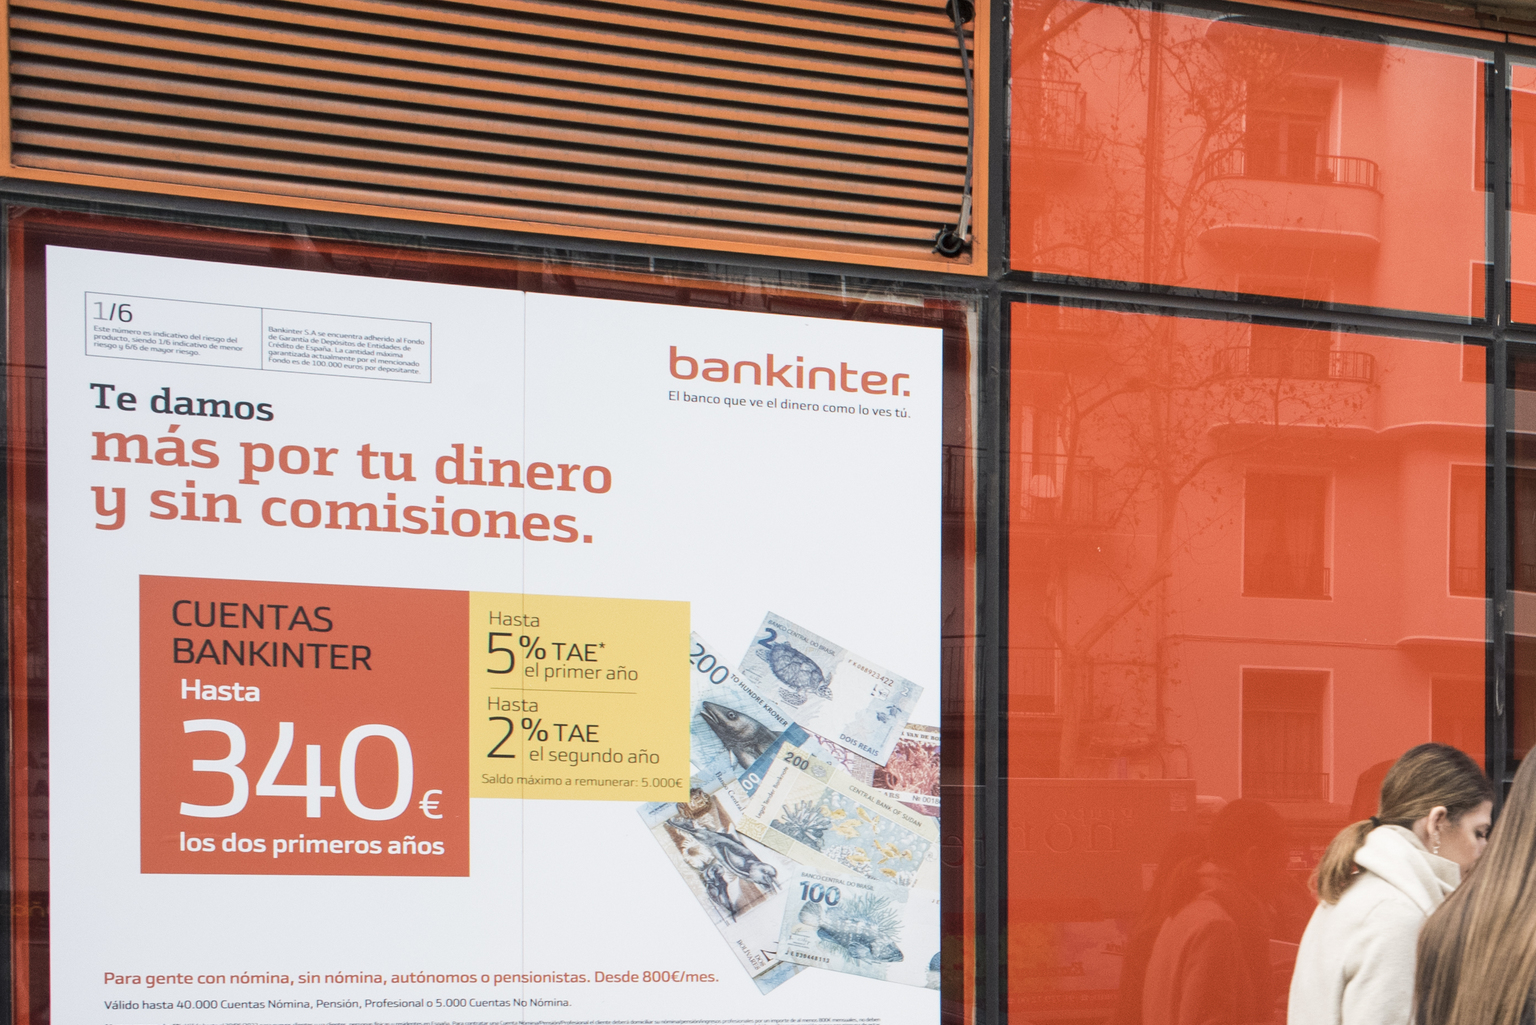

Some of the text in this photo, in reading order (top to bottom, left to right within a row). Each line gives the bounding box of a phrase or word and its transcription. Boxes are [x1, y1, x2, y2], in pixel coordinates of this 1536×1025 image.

[93, 302, 133, 323] 1/6
[94, 325, 110, 333] Este
[112, 327, 141, 335] número
[153, 331, 188, 339] indicativo
[203, 335, 225, 343] riesgo
[94, 334, 130, 342] producto,
[132, 336, 157, 344] siendo
[172, 340, 207, 348] indicativo
[268, 326, 303, 335] Bankinter
[327, 332, 363, 340] encuentra
[279, 335, 309, 343] Garantía
[321, 338, 355, 347] Depósitos
[367, 342, 401, 350] Entidades
[176, 348, 201, 356] riesgo.
[268, 341, 294, 349] Crédito
[306, 345, 333, 353] España.
[345, 348, 375, 356] cantidad
[377, 350, 403, 358] máxima
[268, 350, 310, 358] garantizada
[312, 353, 355, 362] actualmente
[378, 358, 420, 367] mencionado
[268, 356, 290, 364] Fondo
[313, 360, 342, 368] 100.000
[378, 365, 421, 374] depositante.
[669, 345, 910, 397] bankinter.
[90, 383, 275, 421] Te damos
[668, 390, 911, 418] El banco que ve el dinero como lo ves tú.
[91, 424, 613, 493] más por tu dinero
[91, 480, 592, 544] y sin comisiones.
[172, 600, 333, 633] CUENTAS
[489, 610, 540, 628] Hasta
[758, 628, 777, 649] 2
[173, 637, 372, 671] BANKINTER
[690, 643, 729, 684] 200
[524, 663, 639, 682] el primer año
[181, 678, 261, 702] Hasta
[730, 673, 788, 727] TO HUNDRE KRONER
[487, 696, 539, 712] Hasta
[553, 722, 600, 743] TAE
[840, 734, 879, 757] DOIS REAIS
[529, 747, 660, 766] el segundo año
[784, 752, 809, 770] 200
[481, 773, 683, 789] Saldo máximo a remunerar: 5.000€
[849, 785, 874, 802] CENTRAL
[875, 800, 892, 811] BANK
[902, 814, 922, 827] SUDAN
[179, 832, 445, 859] los dos primeros años
[800, 881, 841, 906] 100
[104, 970, 719, 988] Para gente con nómina, sin nómina, autónomos o pensionistas. Desde 800€/mes.
[104, 998, 572, 1010] Válido hasta 40.000 Cuentas Nómina, Pensión, Profesional o 5.000 Cuentas No Nómina.
